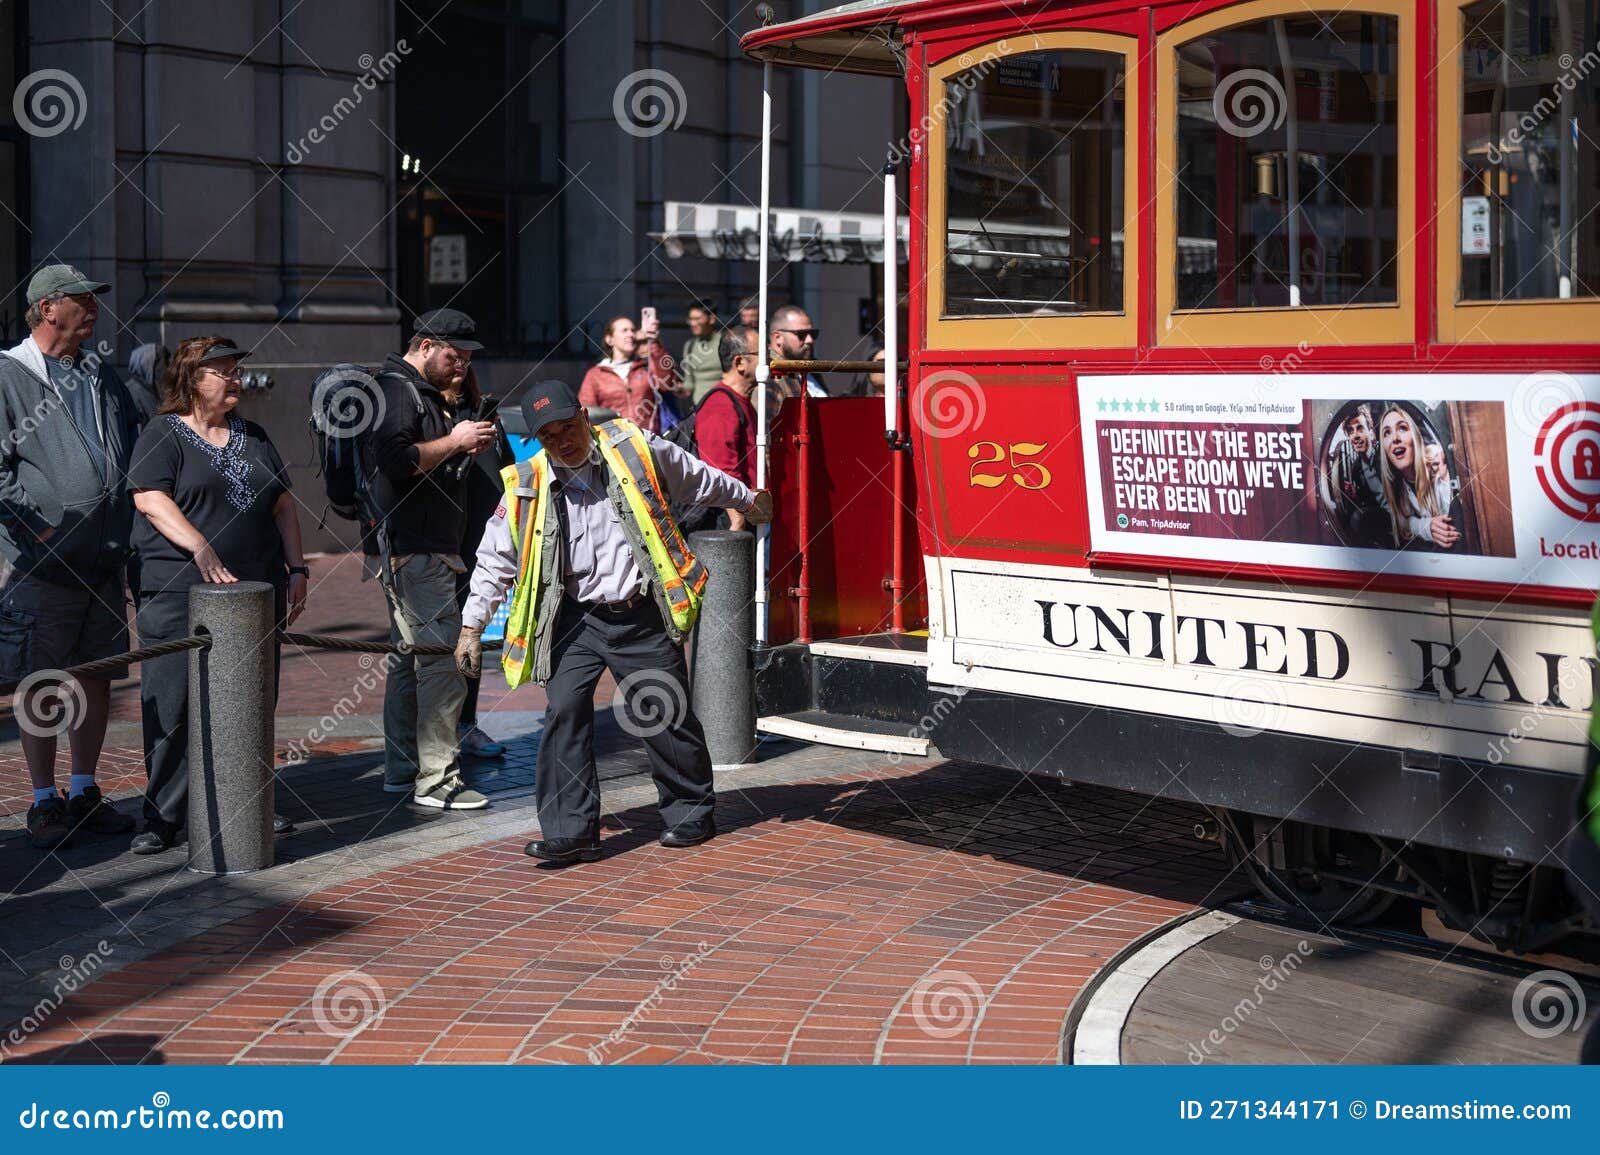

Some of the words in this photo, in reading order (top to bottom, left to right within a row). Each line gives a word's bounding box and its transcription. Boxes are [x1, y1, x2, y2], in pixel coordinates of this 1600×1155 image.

[1164, 402, 1175, 411] 5.0
[1176, 402, 1194, 414] rating
[1230, 403, 1242, 414] Yelp
[1258, 403, 1295, 415] TripAdvisor
[1212, 431, 1249, 458] THE
[1254, 432, 1304, 460] BEST
[968, 441, 1052, 490] 25
[1112, 456, 1180, 484] ESCAPE
[1184, 458, 1238, 487] ROOM
[1115, 484, 1160, 511] EVER
[1163, 485, 1211, 514] BEEN
[1131, 517, 1149, 528] Pam,
[1150, 518, 1191, 531] TripAdvisor
[1540, 537, 1600, 560] Locat
[1033, 600, 1350, 681] UNITED
